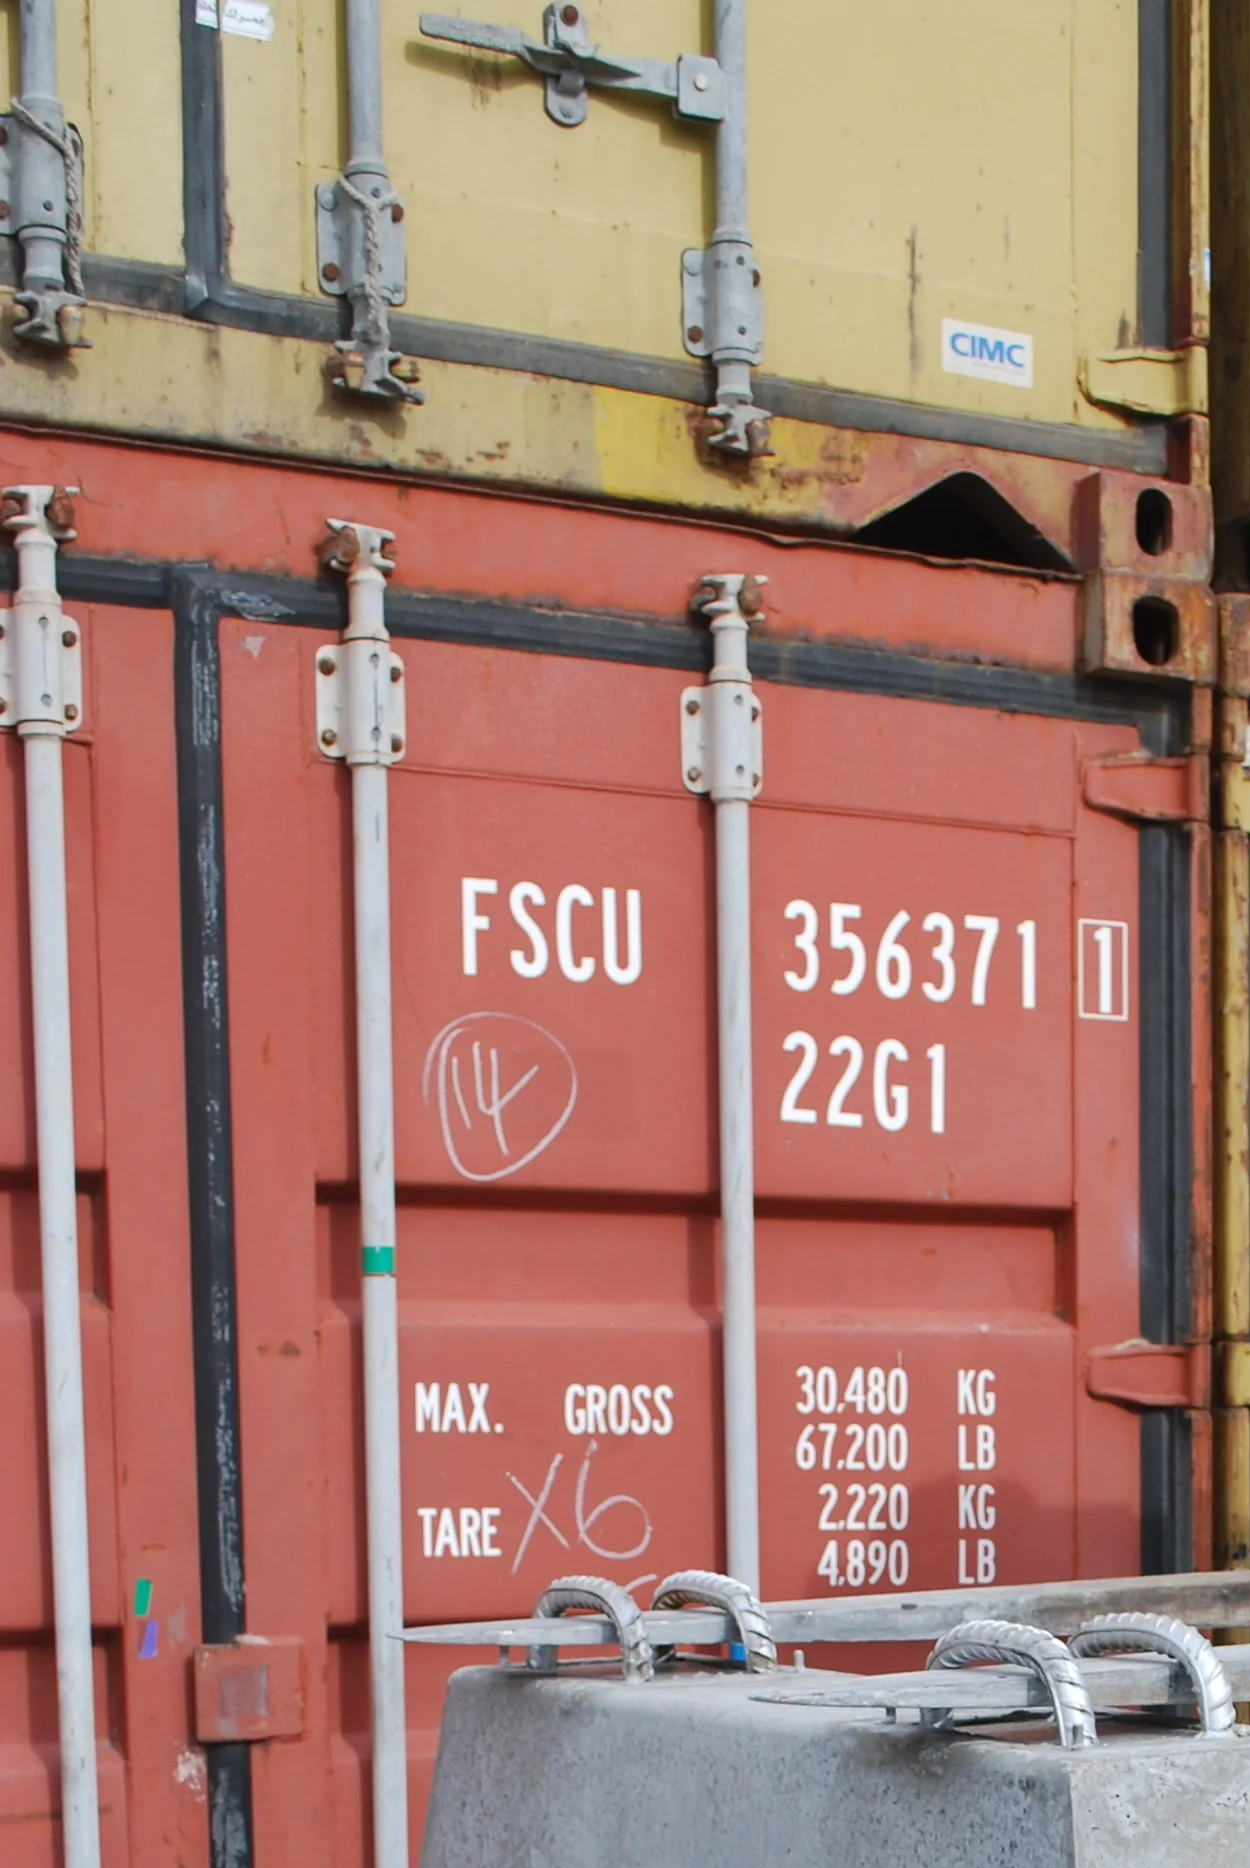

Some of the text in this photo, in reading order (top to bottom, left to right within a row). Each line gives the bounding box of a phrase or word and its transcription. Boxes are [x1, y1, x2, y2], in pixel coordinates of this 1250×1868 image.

[949, 332, 1026, 368] CIMC
[461, 877, 642, 985] FSCU
[783, 899, 1037, 1009] 356371
[780, 1030, 946, 1134] 22G1
[415, 1382, 674, 1436] MAX. GROSS
[957, 1369, 996, 1417] KG
[958, 1424, 996, 1471] LB
[957, 1484, 996, 1531] KG
[417, 1507, 502, 1558] TARE
[958, 1539, 996, 1585] LB
